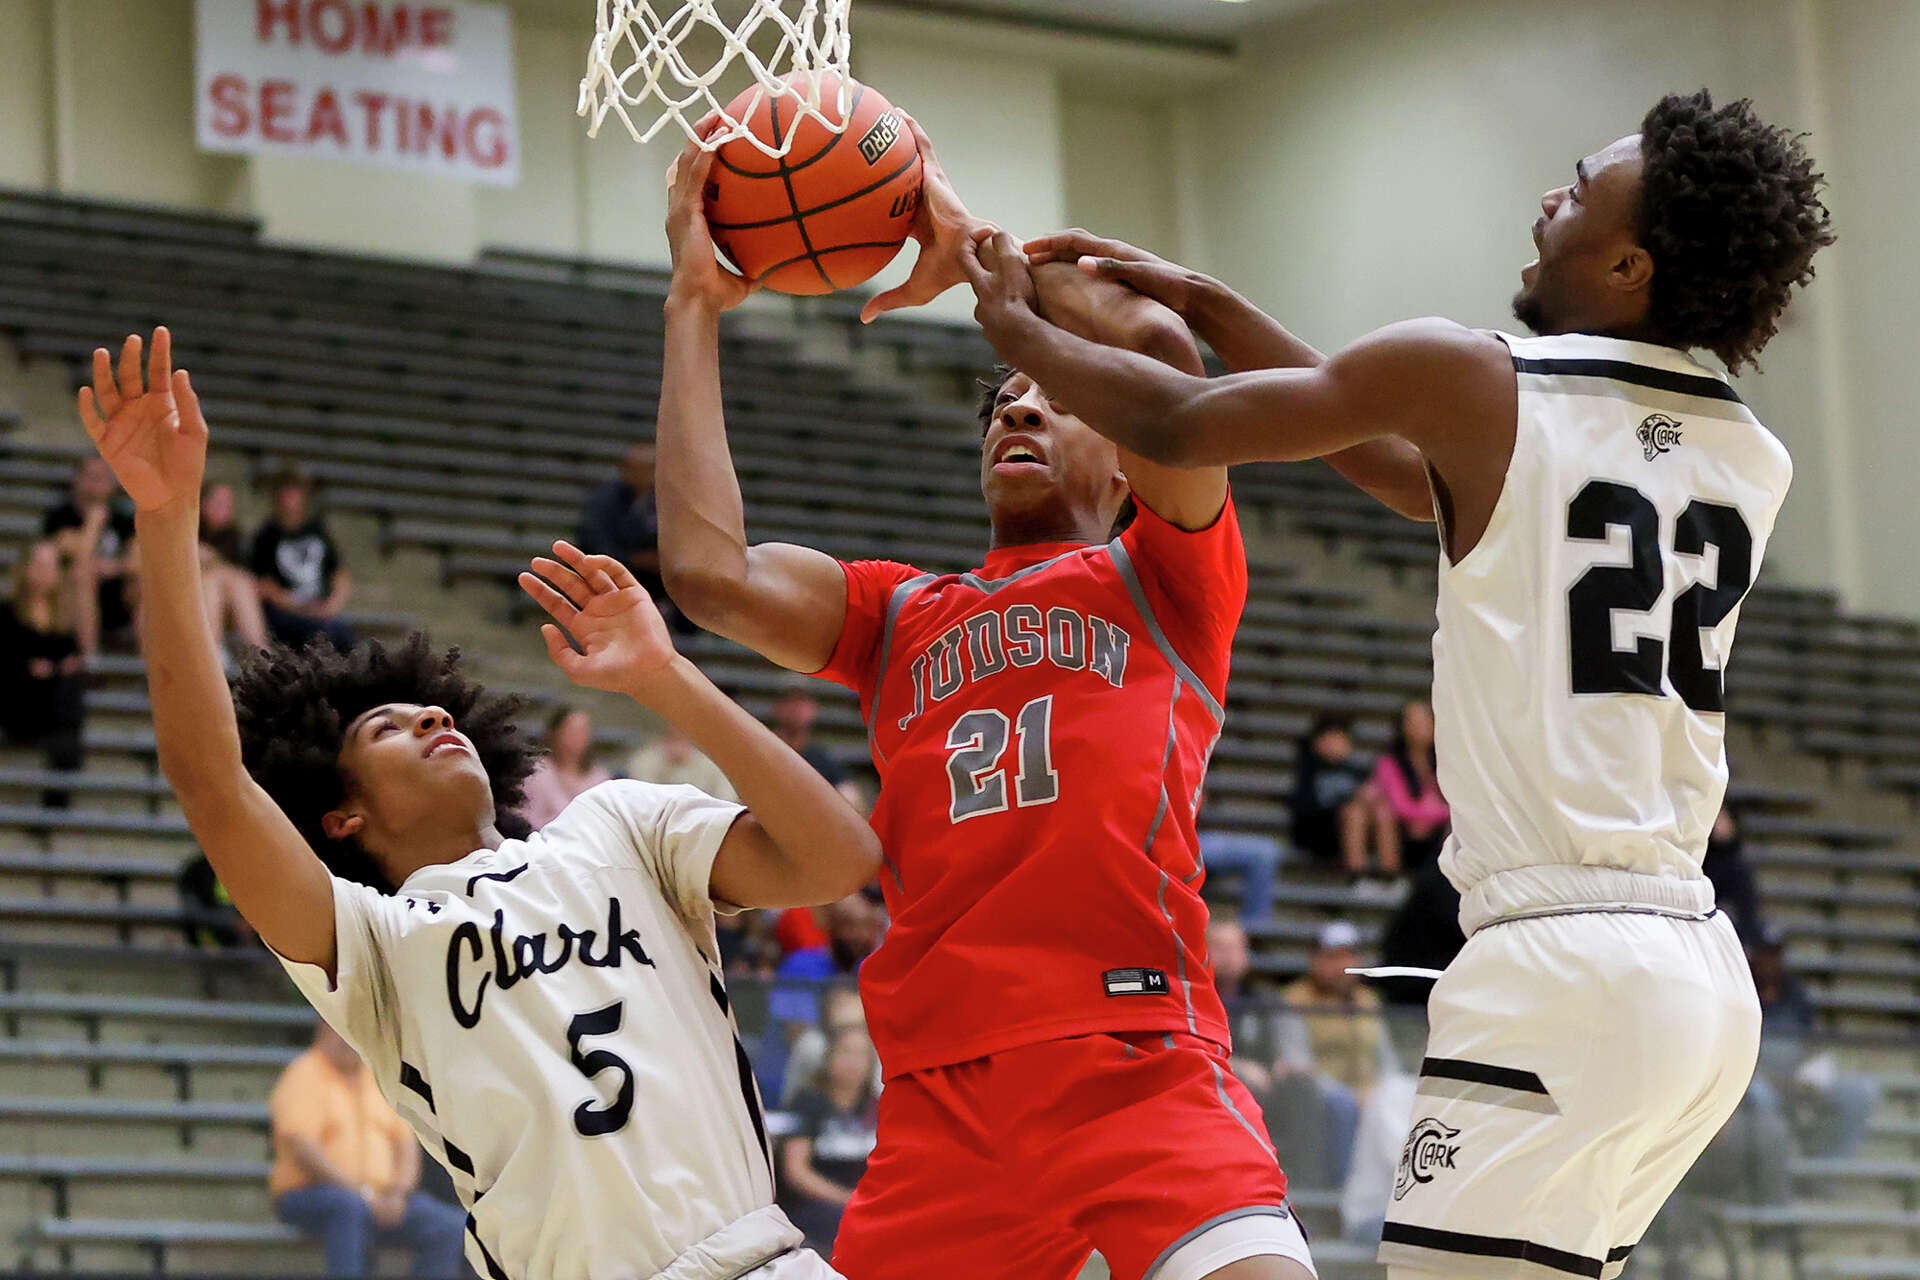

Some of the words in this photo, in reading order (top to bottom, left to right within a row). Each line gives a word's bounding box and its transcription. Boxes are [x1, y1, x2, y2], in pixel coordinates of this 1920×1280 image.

[256, 0, 455, 57] HOME
[209, 72, 509, 169] SEATING
[1565, 477, 1752, 713] 22
[898, 604, 1130, 731] JUDSON
[945, 694, 1058, 824] 21
[447, 897, 656, 1029] Clark
[1148, 974, 1162, 986] M
[567, 1000, 635, 1137] 5
[1412, 1130, 1461, 1184] CLARK
